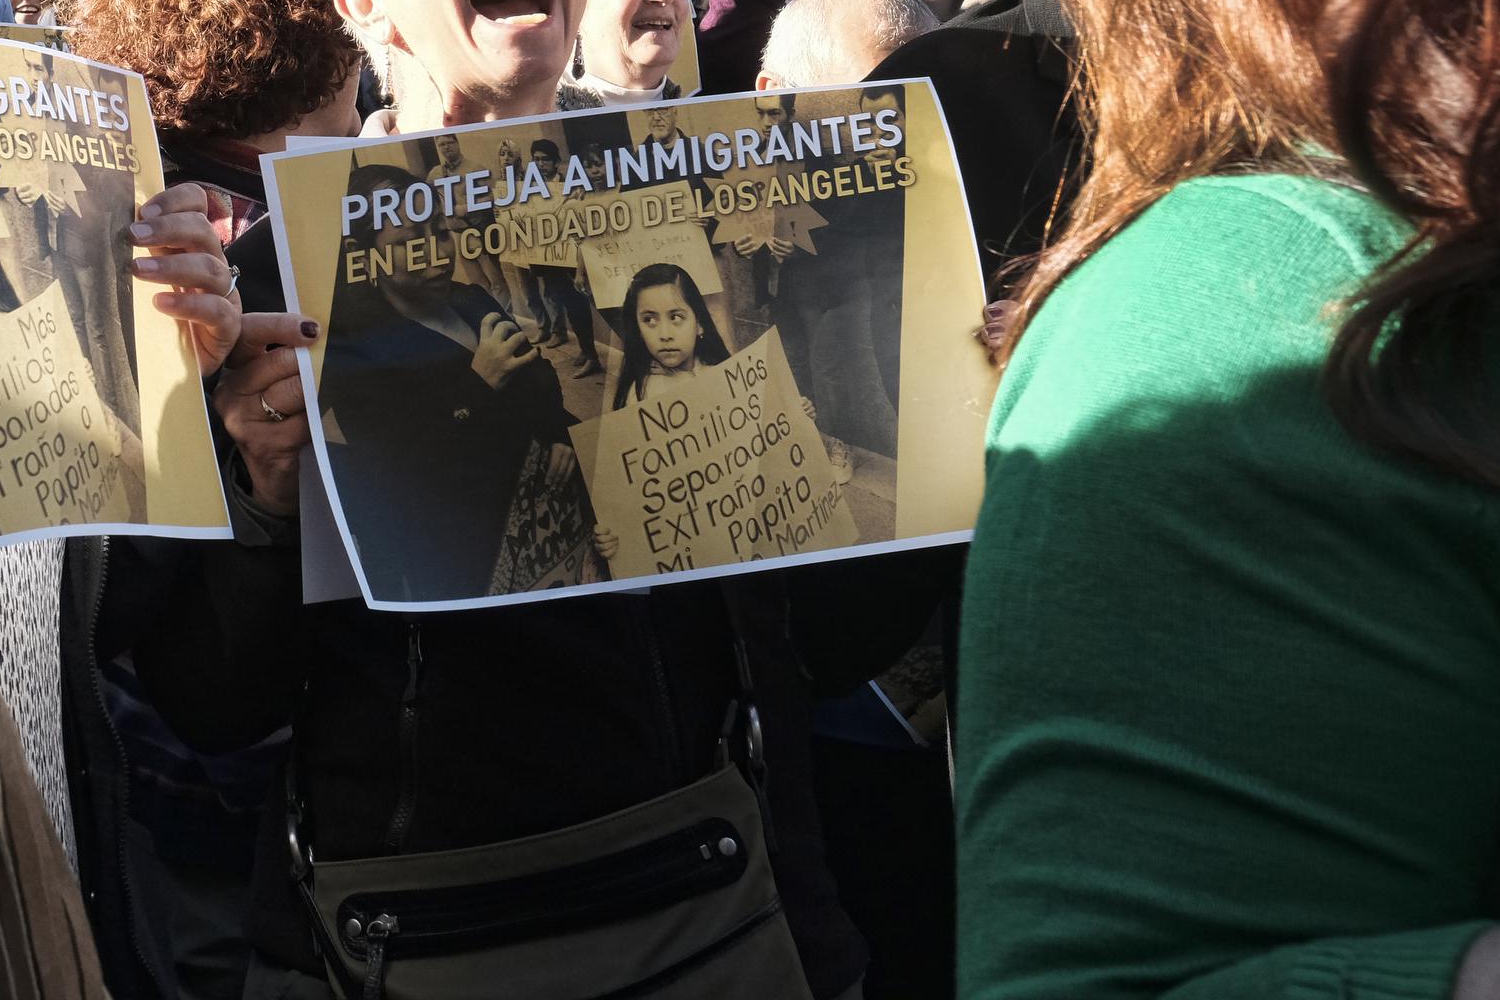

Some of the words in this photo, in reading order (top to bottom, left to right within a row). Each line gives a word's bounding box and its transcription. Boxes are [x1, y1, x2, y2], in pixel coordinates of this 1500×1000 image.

[40, 128, 142, 174] ANGELES
[341, 160, 551, 236] PROTEJA
[561, 155, 594, 196] A
[604, 108, 904, 189] INMIGRANTES
[345, 243, 395, 285] EN
[411, 235, 451, 272] EL
[458, 199, 632, 261] CONDADO
[641, 190, 687, 228] DE
[694, 180, 759, 219] LOS
[766, 156, 917, 209] ANGELES
[17, 306, 57, 350] Más
[621, 394, 762, 485] Familias
[638, 400, 690, 442] No
[723, 355, 768, 399] Más
[35, 441, 100, 518] Papito
[642, 412, 791, 514] Separadas
[790, 443, 806, 467] a
[655, 546, 695, 575] Mi
[727, 475, 812, 555] Papito
